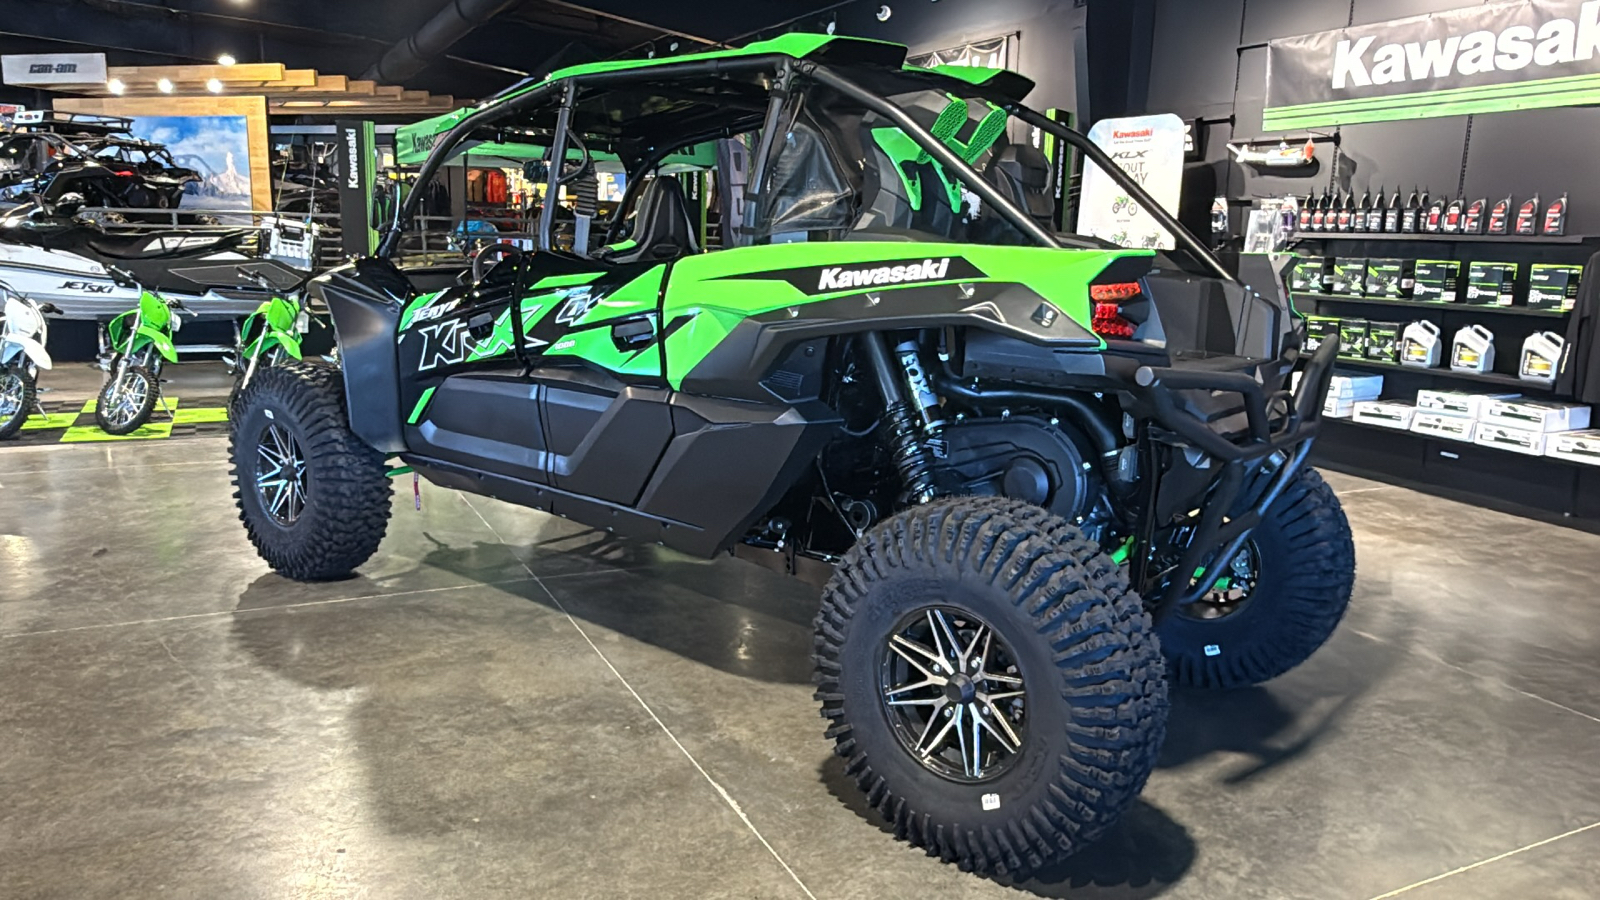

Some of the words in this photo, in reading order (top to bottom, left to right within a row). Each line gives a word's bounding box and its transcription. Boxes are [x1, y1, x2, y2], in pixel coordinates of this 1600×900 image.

[1113, 128, 1153, 139] Kawasaki
[345, 128, 359, 189] Kawasaki
[1112, 150, 1149, 159] KLX
[1120, 162, 1145, 174] OUT
[818, 258, 950, 290] Kawasaki
[901, 352, 932, 400] FOX
